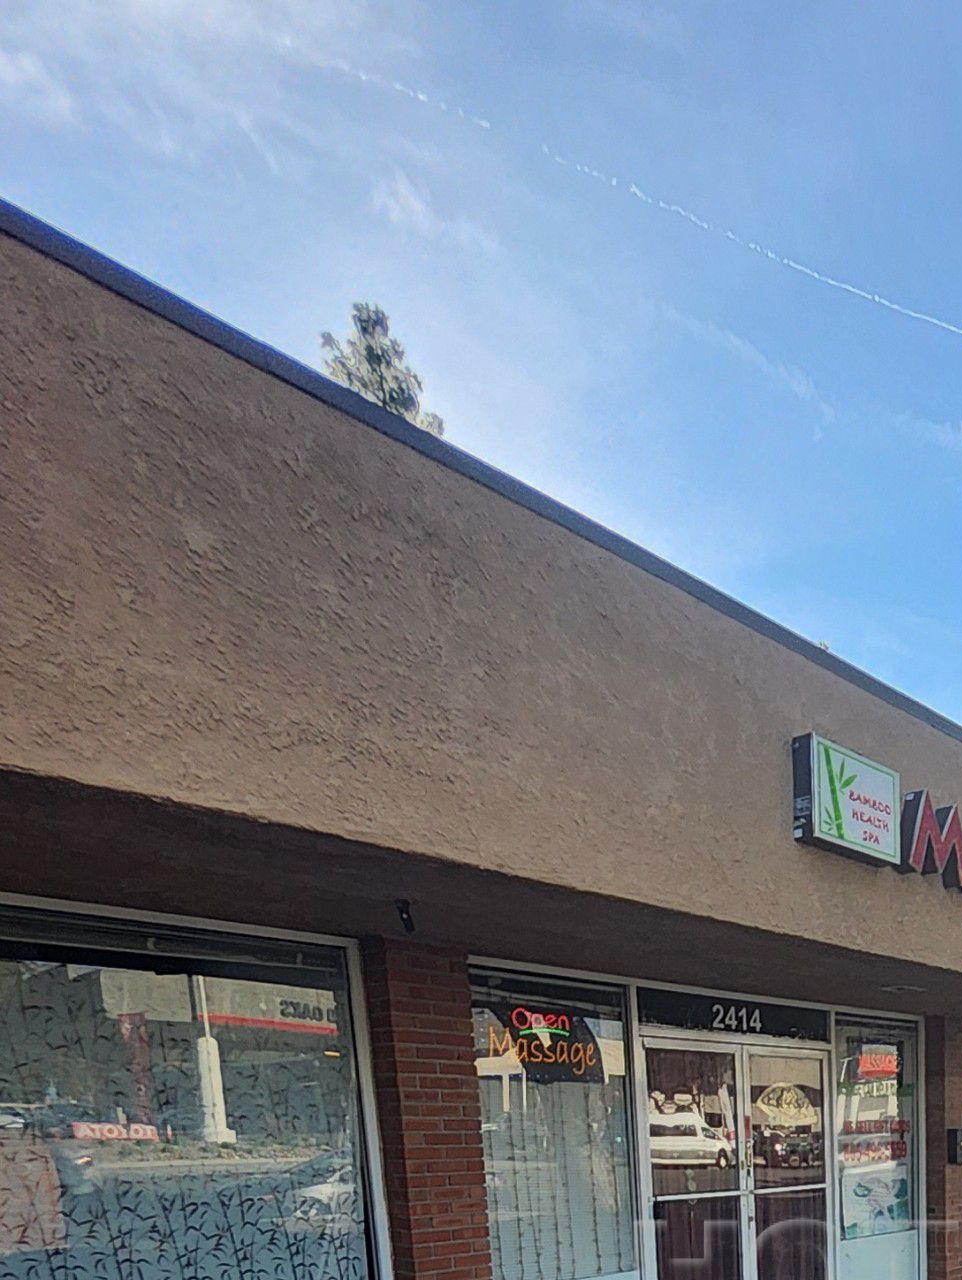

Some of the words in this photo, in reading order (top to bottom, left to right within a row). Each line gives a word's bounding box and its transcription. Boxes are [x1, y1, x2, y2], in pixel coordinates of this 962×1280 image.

[848, 789, 892, 816] BAMBOO
[851, 808, 890, 833] HEALTH
[862, 829, 881, 845] SPA
[510, 1006, 570, 1031] Open
[711, 1004, 762, 1032] 2414
[488, 1024, 597, 1076] Massage
